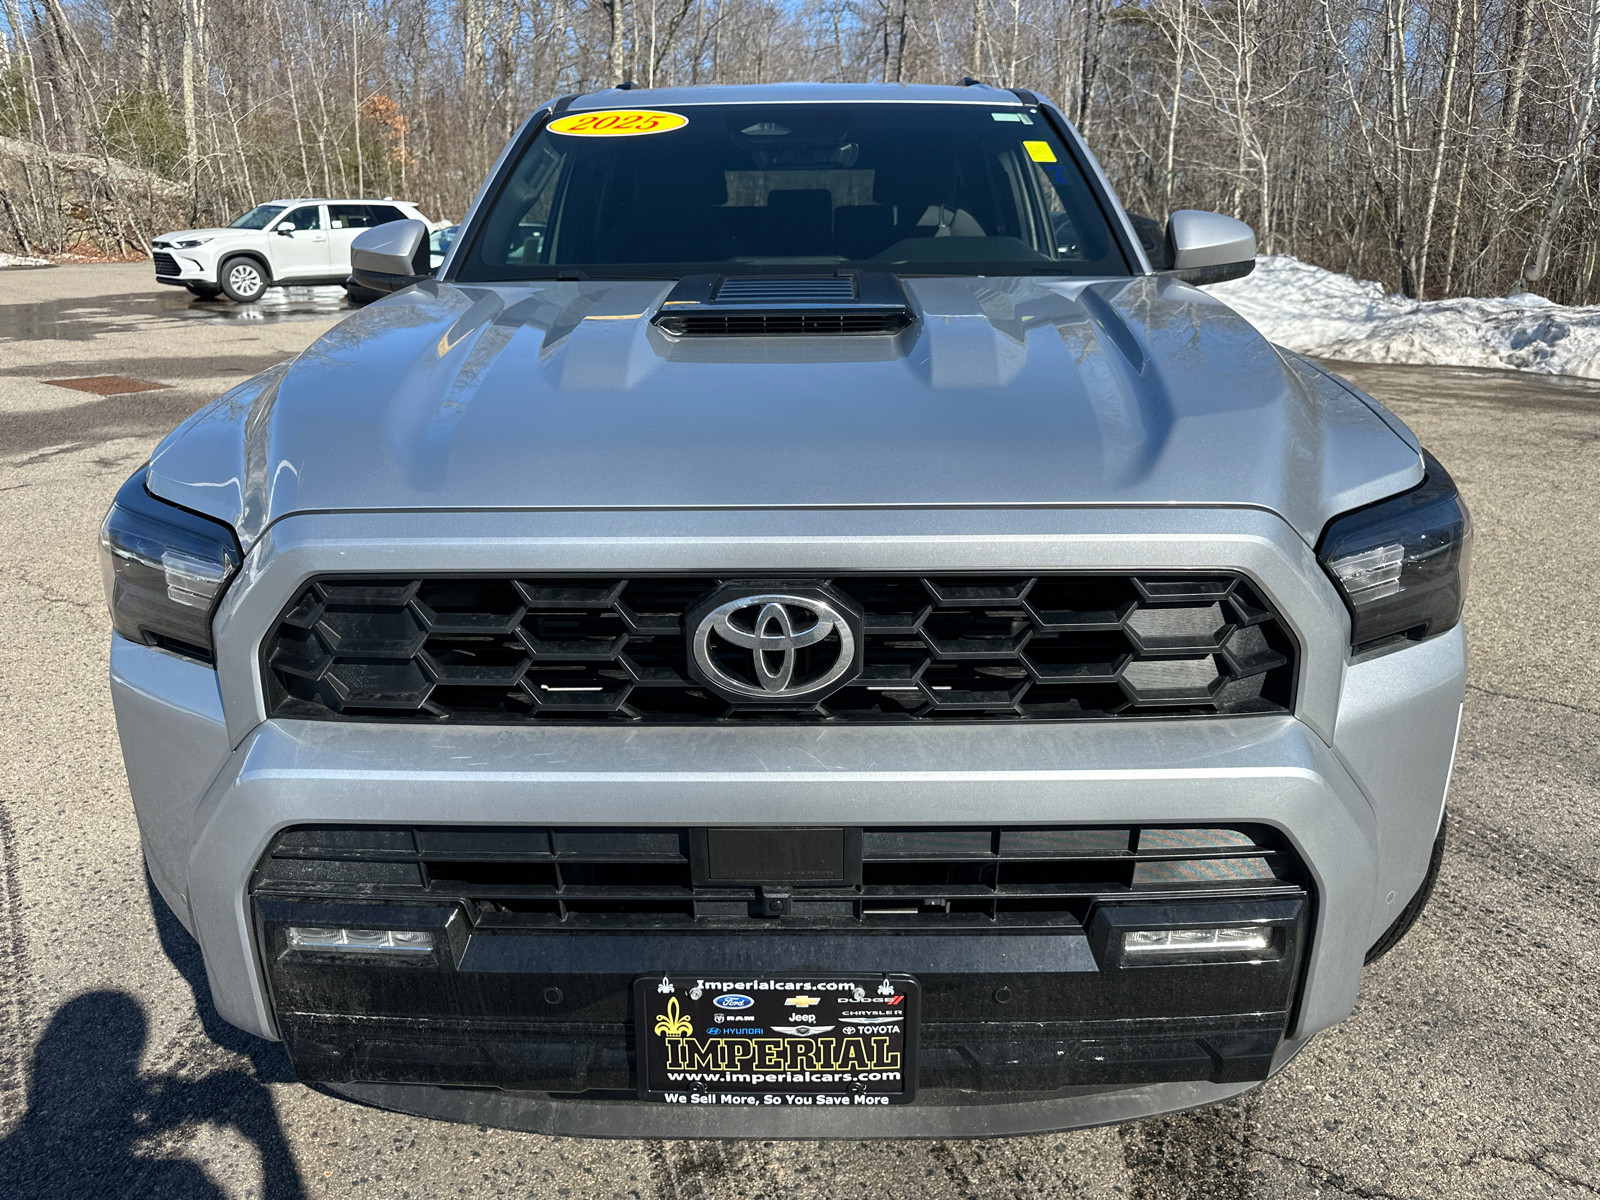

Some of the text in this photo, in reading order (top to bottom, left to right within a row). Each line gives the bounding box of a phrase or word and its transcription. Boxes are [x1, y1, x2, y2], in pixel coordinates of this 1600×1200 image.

[567, 115, 668, 131] 2025
[697, 980, 855, 992] Imperialcars.com
[722, 996, 745, 1006] Ford
[788, 1012, 816, 1023] Jeep
[857, 1025, 901, 1034] TOYOTA
[665, 1037, 901, 1071] IMPERIAL
[667, 1071, 901, 1084] www.imperialcars.com
[664, 1093, 889, 1106] We Sell More, So You Save More
